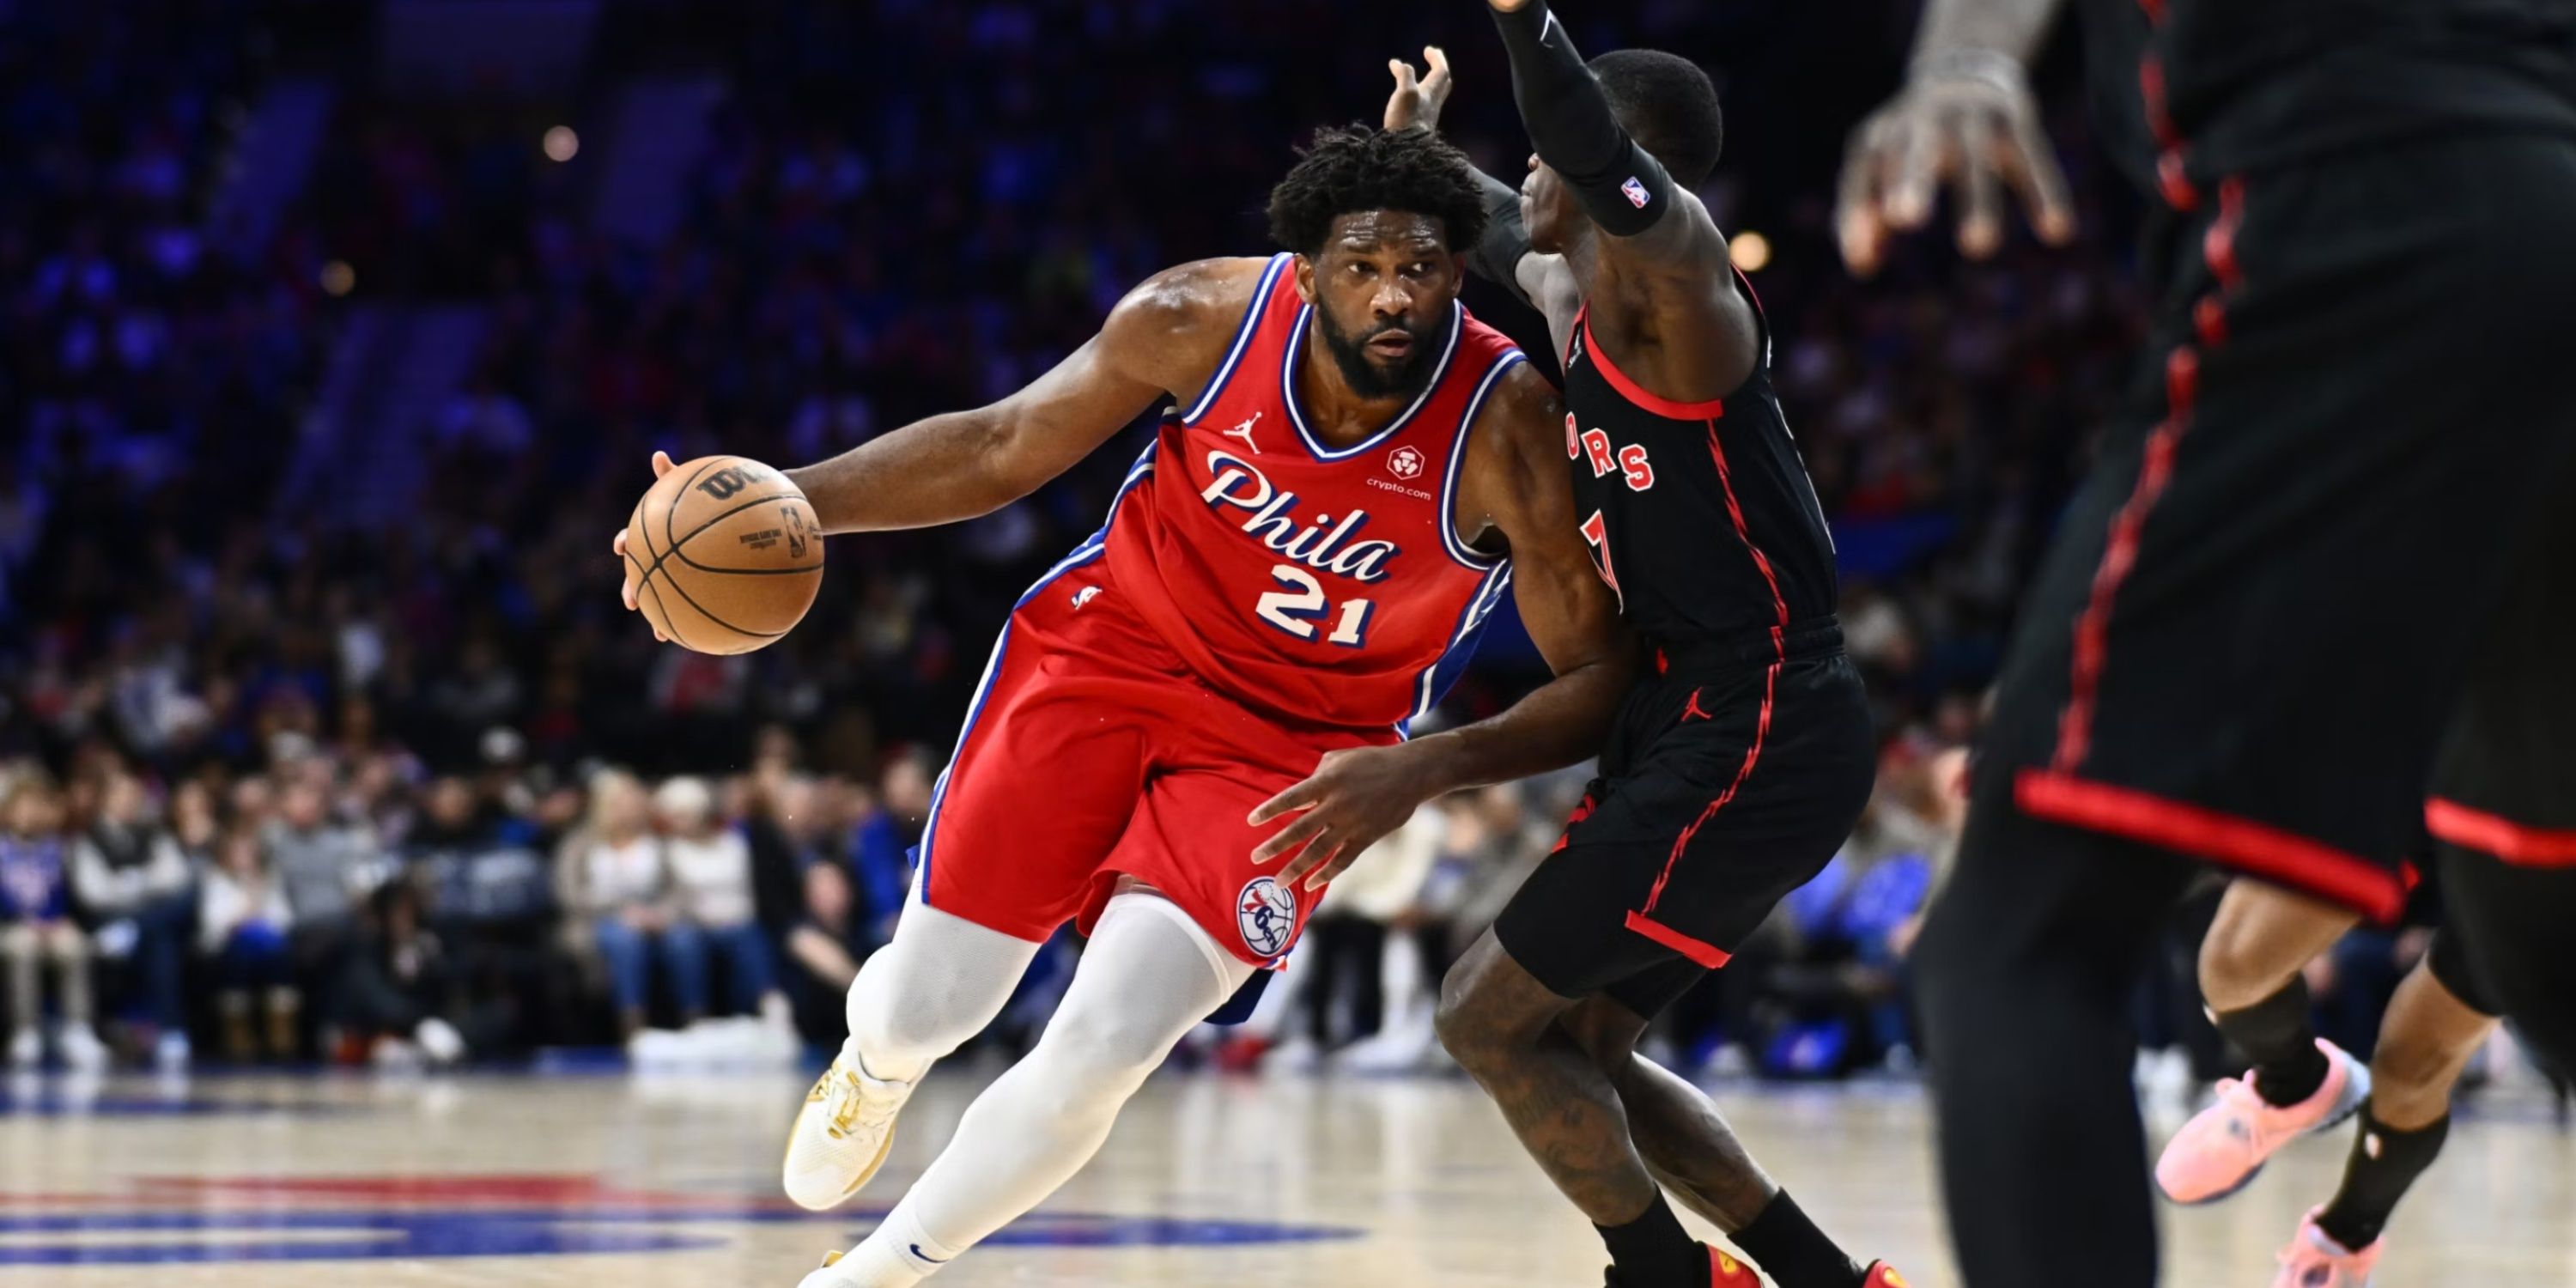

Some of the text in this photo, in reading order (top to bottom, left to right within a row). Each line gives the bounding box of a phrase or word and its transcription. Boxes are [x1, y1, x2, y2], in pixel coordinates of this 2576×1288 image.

[1200, 450, 1400, 585] Phila
[1366, 477, 1431, 501] crypto.com
[1255, 563, 1376, 650] 21
